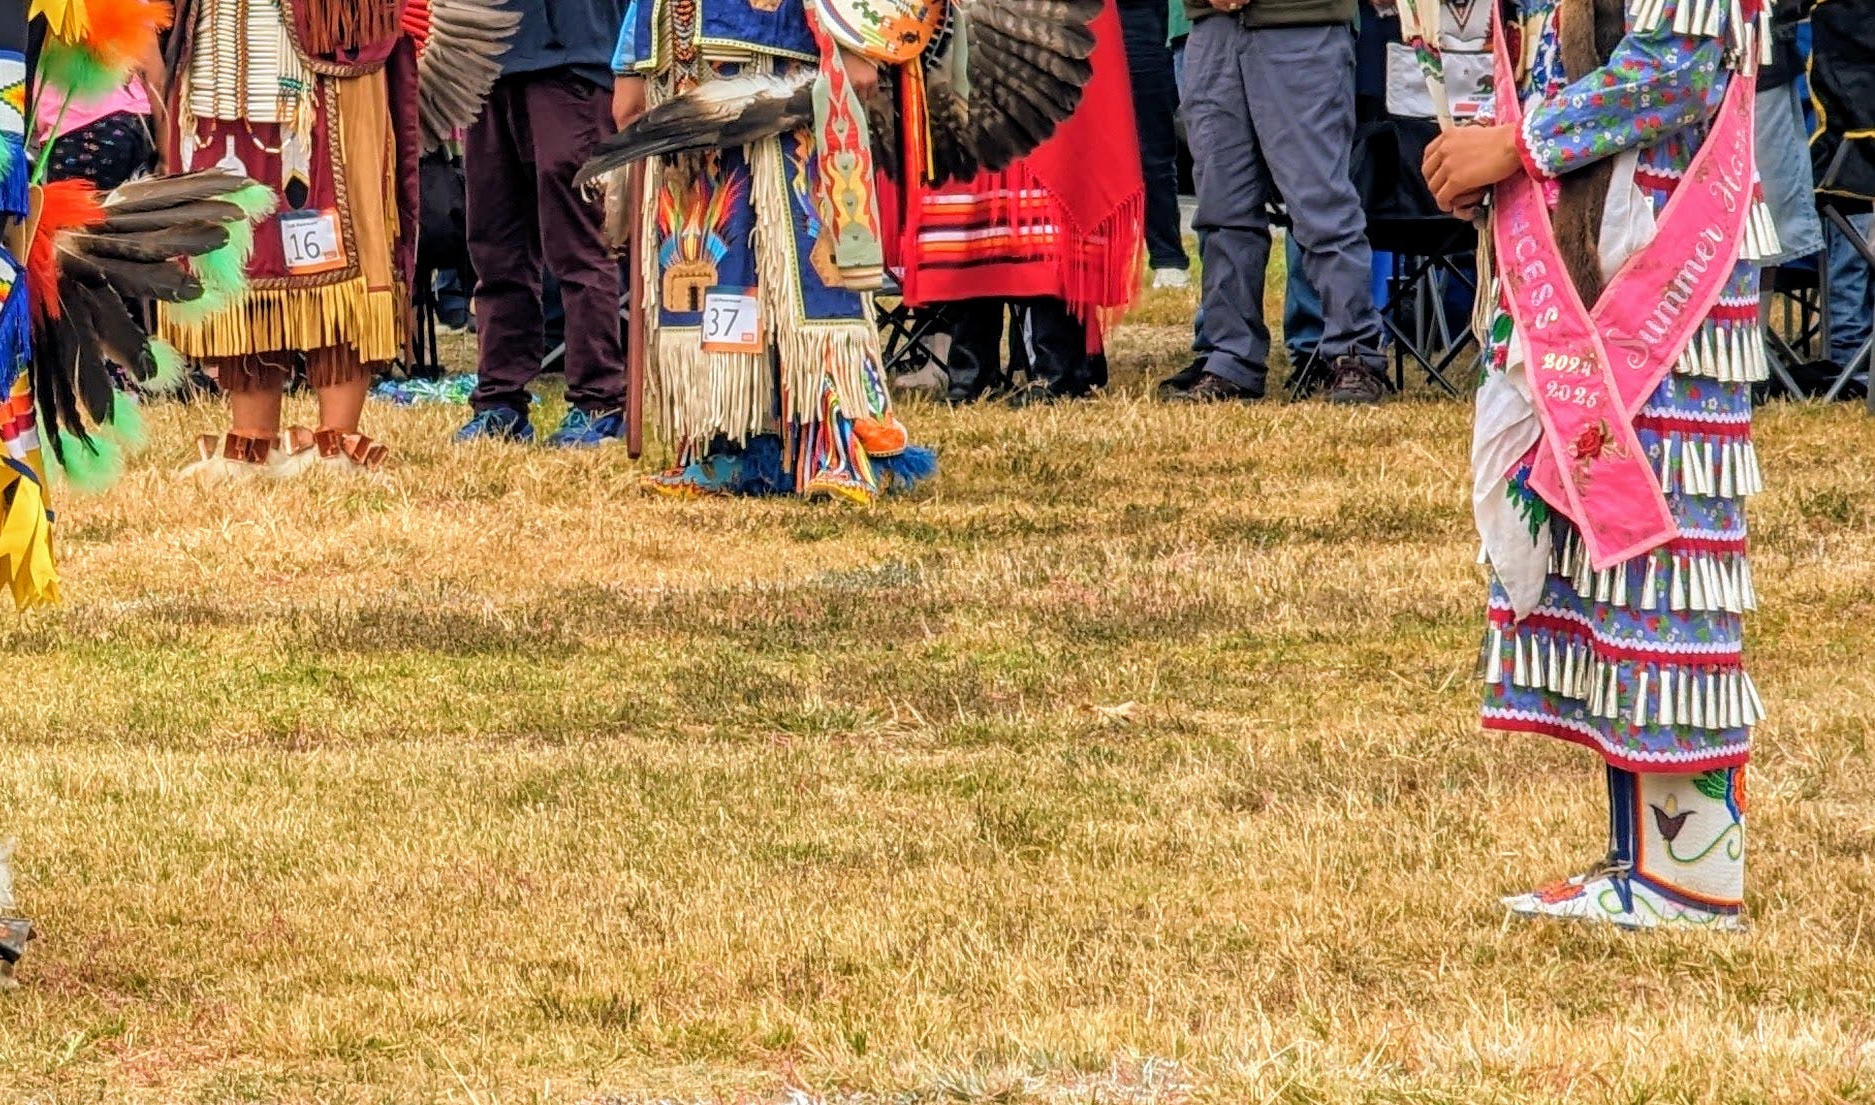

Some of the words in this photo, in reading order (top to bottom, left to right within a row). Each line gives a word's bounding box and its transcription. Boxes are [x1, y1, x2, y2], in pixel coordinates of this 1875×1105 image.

[289, 230, 321, 260] 16
[1605, 222, 1724, 370] Summer
[708, 307, 740, 337] 37
